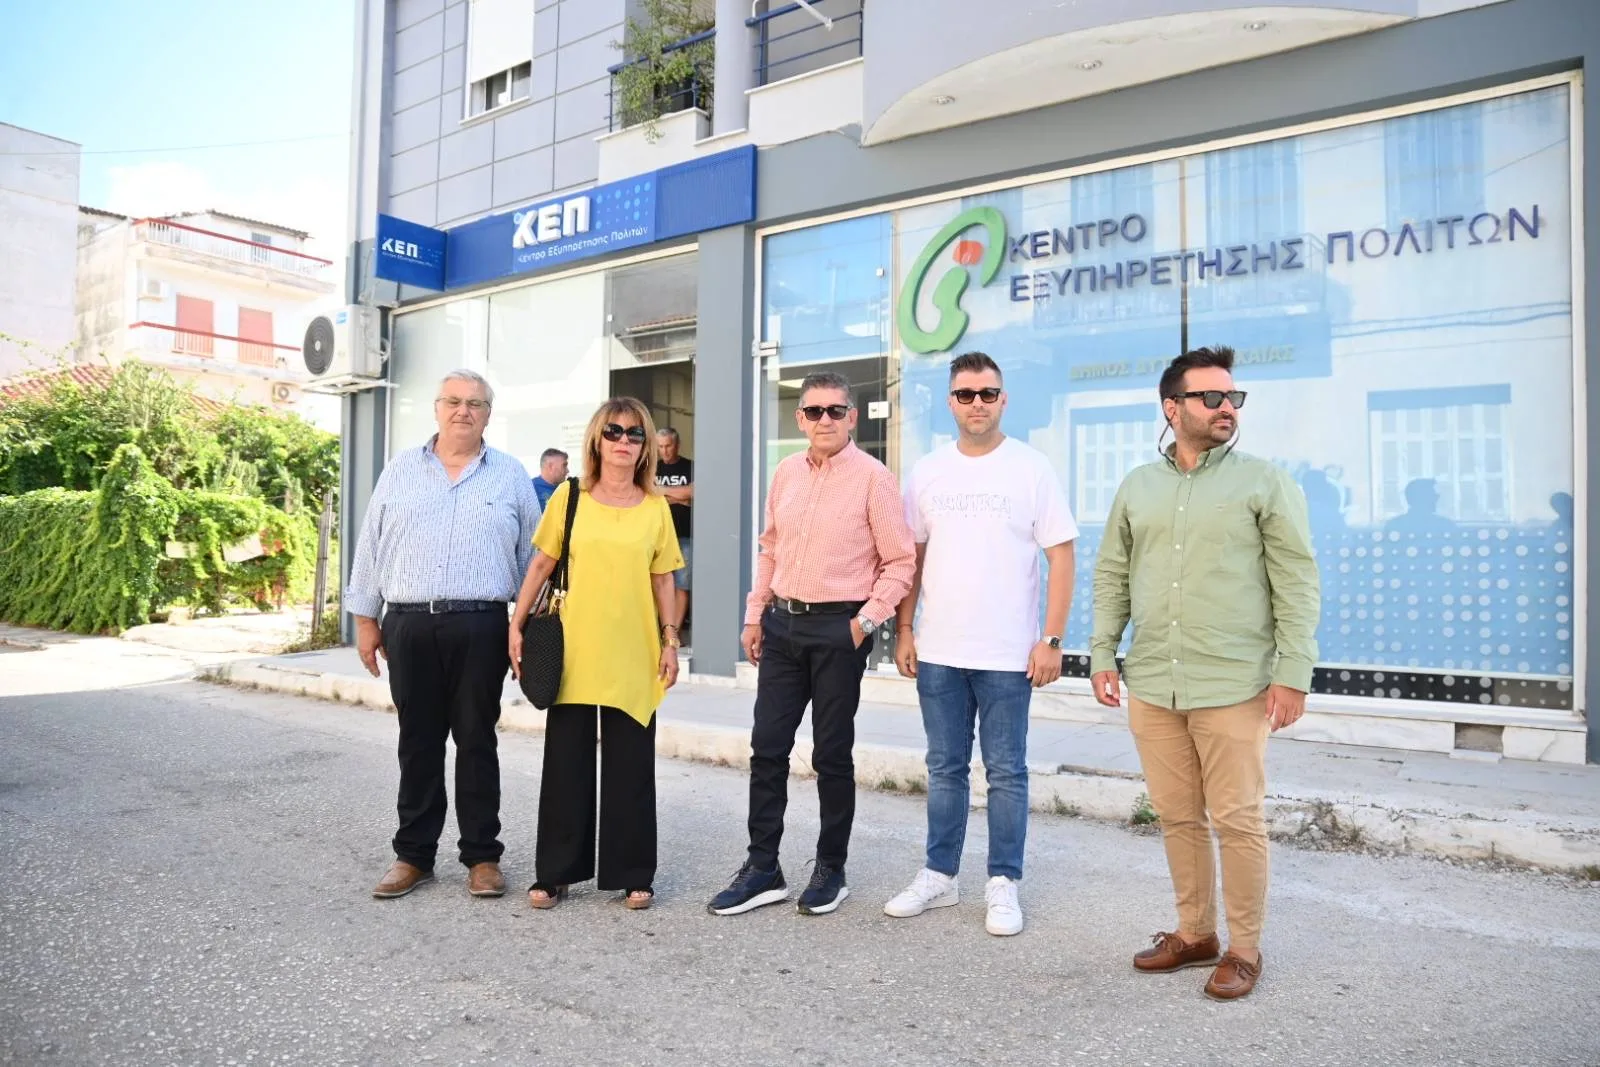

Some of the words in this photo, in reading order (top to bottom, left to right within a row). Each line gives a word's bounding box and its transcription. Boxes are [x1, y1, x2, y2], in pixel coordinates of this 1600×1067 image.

[382, 238, 418, 258] ΚΕΠ
[513, 196, 591, 249] ΚΕΠ
[1008, 213, 1147, 263] ΚΕΝΤΡΟ
[1010, 238, 1304, 301] ΕΞΥΠΗΡΕΤΗΣΗΣ
[1327, 204, 1539, 264] ΠΟΛΙΤΩΝ
